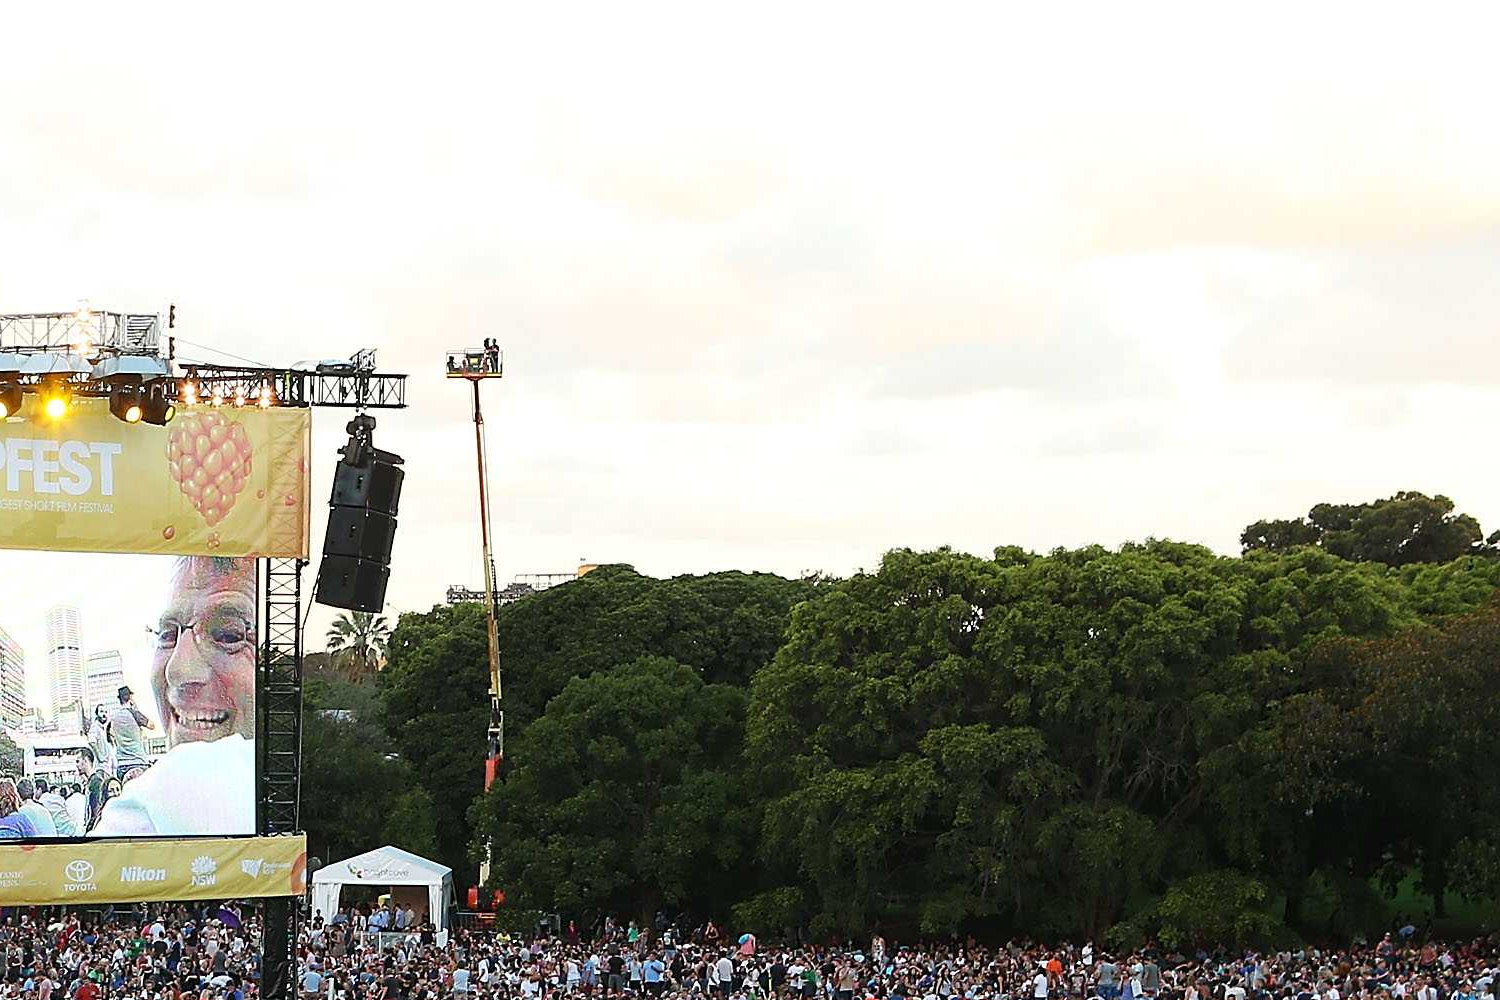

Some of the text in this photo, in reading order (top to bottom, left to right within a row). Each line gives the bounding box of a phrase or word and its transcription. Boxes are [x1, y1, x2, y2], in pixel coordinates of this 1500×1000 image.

[78, 502, 114, 514] FESTIVAL
[120, 867, 166, 882] Nikon
[191, 874, 216, 886] NSW
[64, 883, 97, 892] TOYOTA
